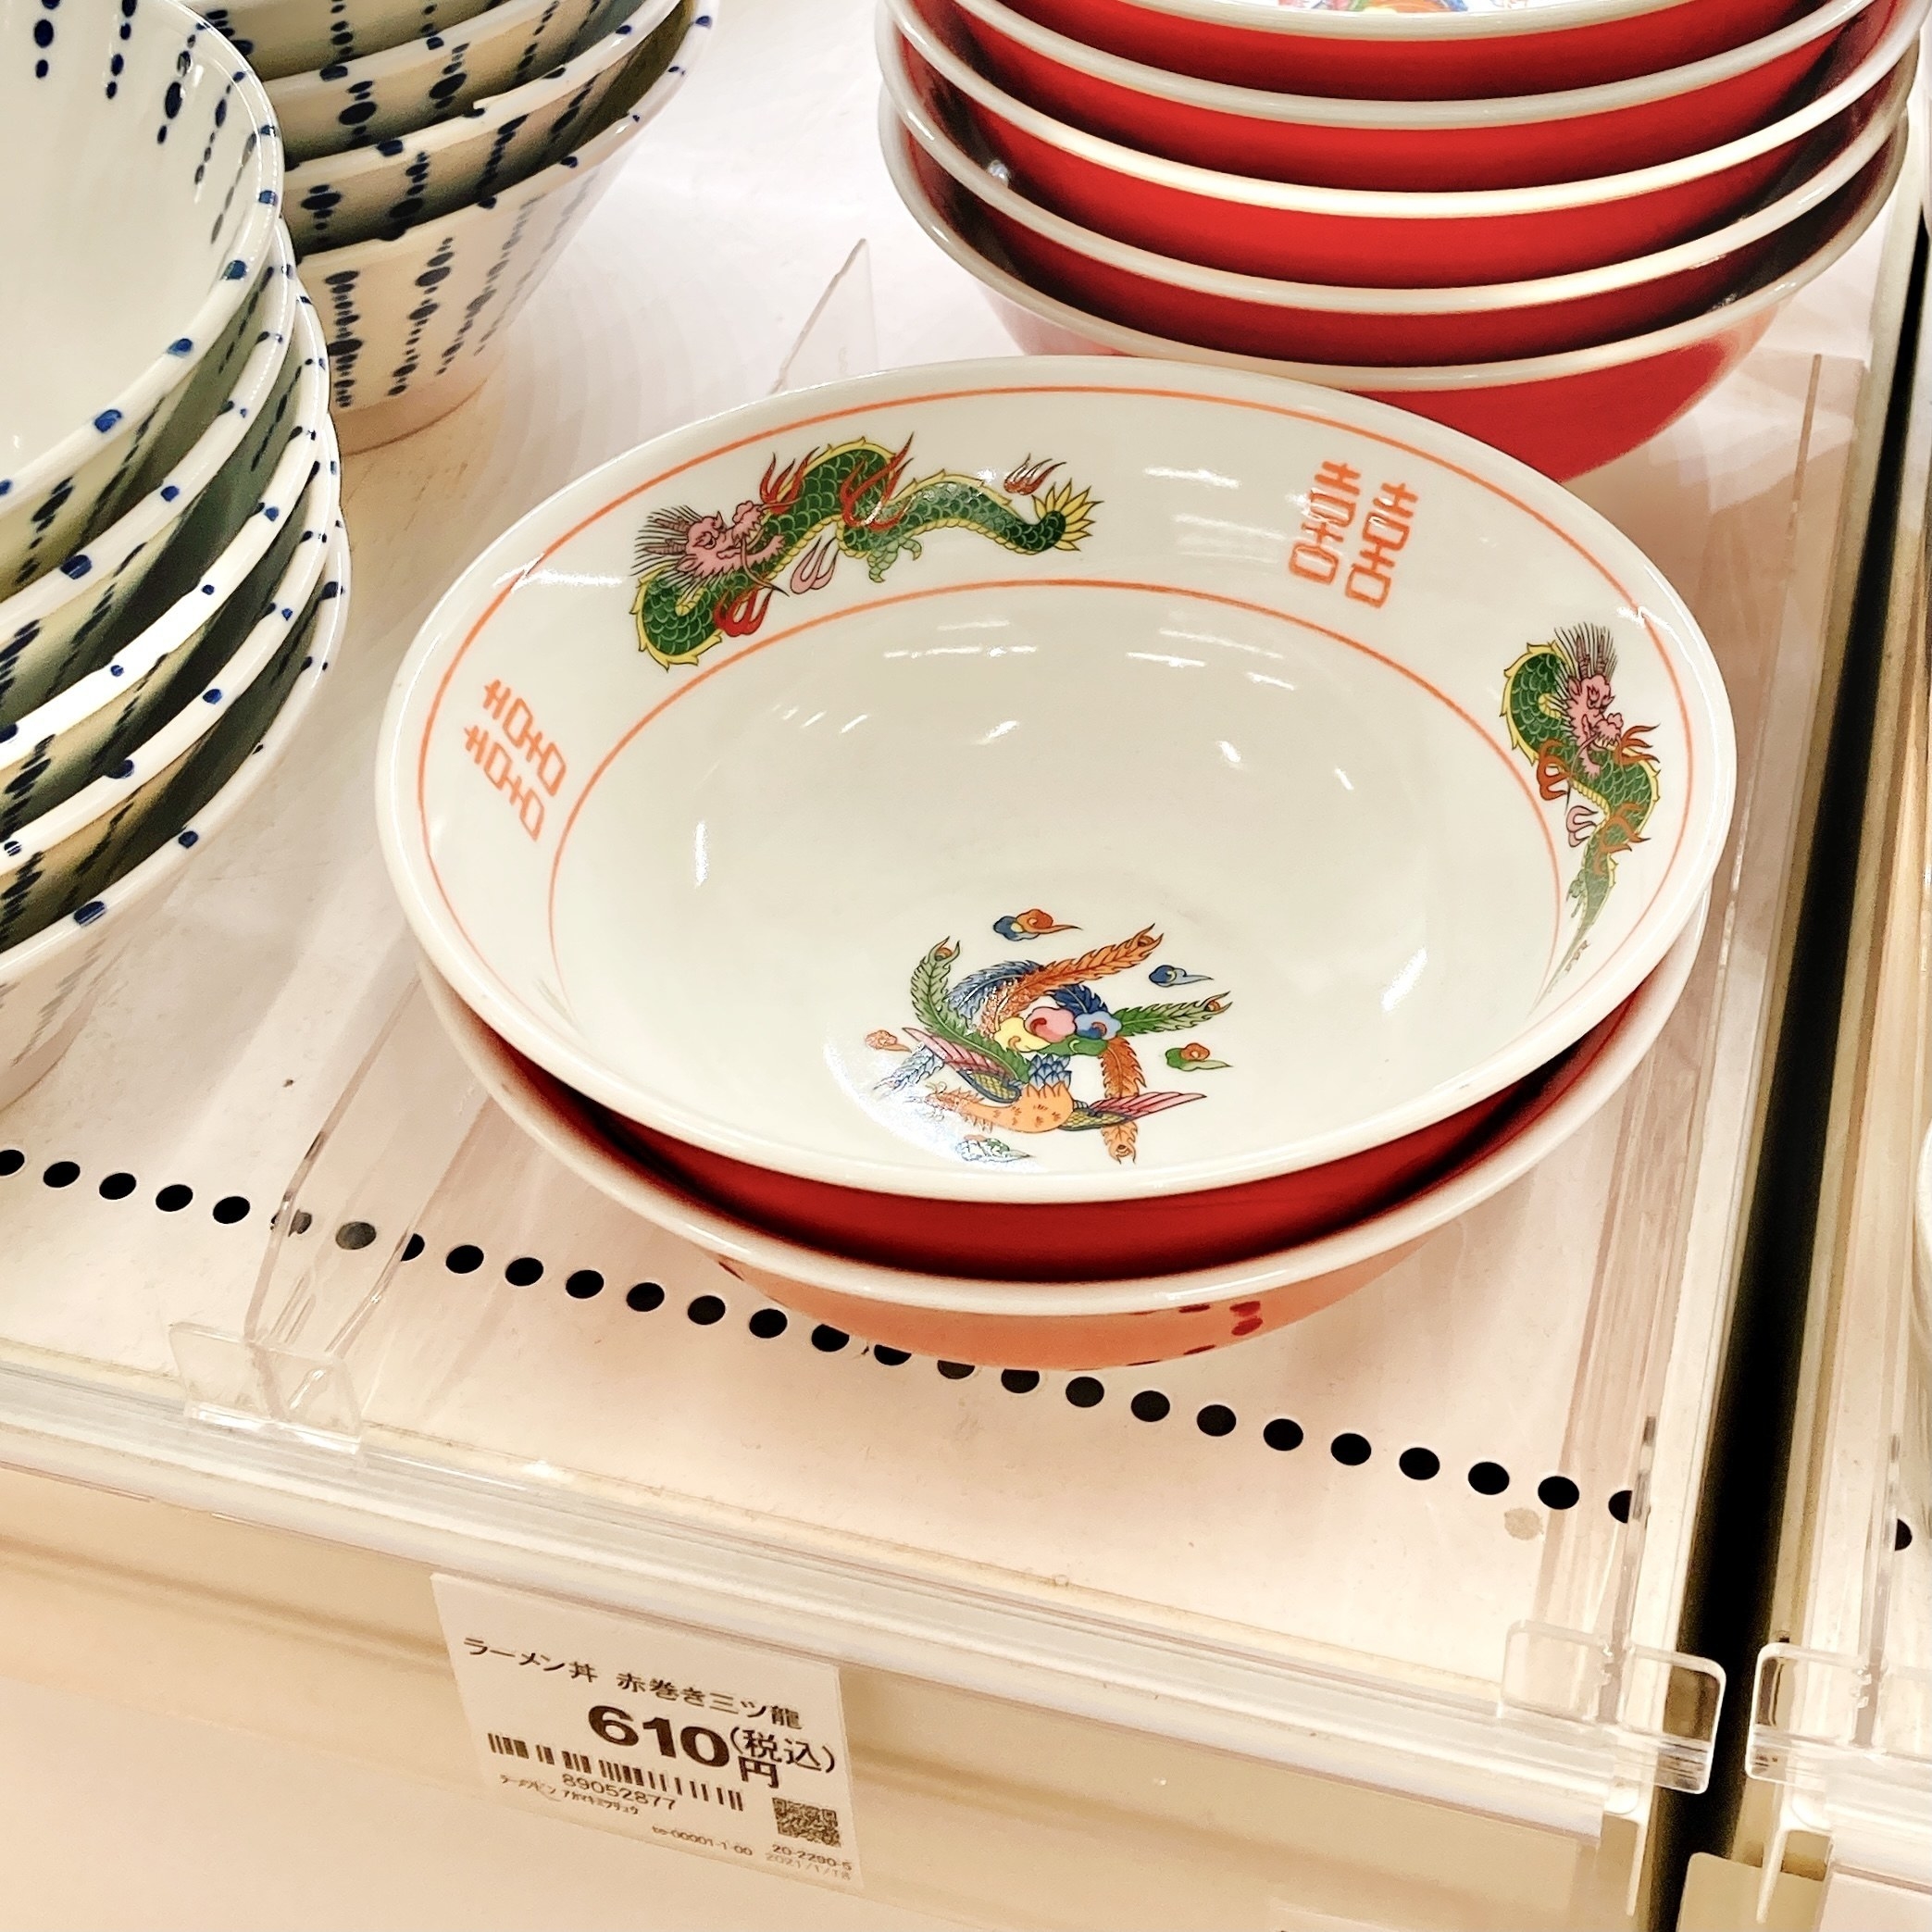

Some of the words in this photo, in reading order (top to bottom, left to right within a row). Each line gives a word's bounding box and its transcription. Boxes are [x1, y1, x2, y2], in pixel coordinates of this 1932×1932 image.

[464, 1637, 598, 1683] ラーメン丼
[616, 1672, 804, 1730] 赤巻き三ツ龍
[588, 1704, 730, 1768] 610
[561, 1772, 677, 1811] 89052877
